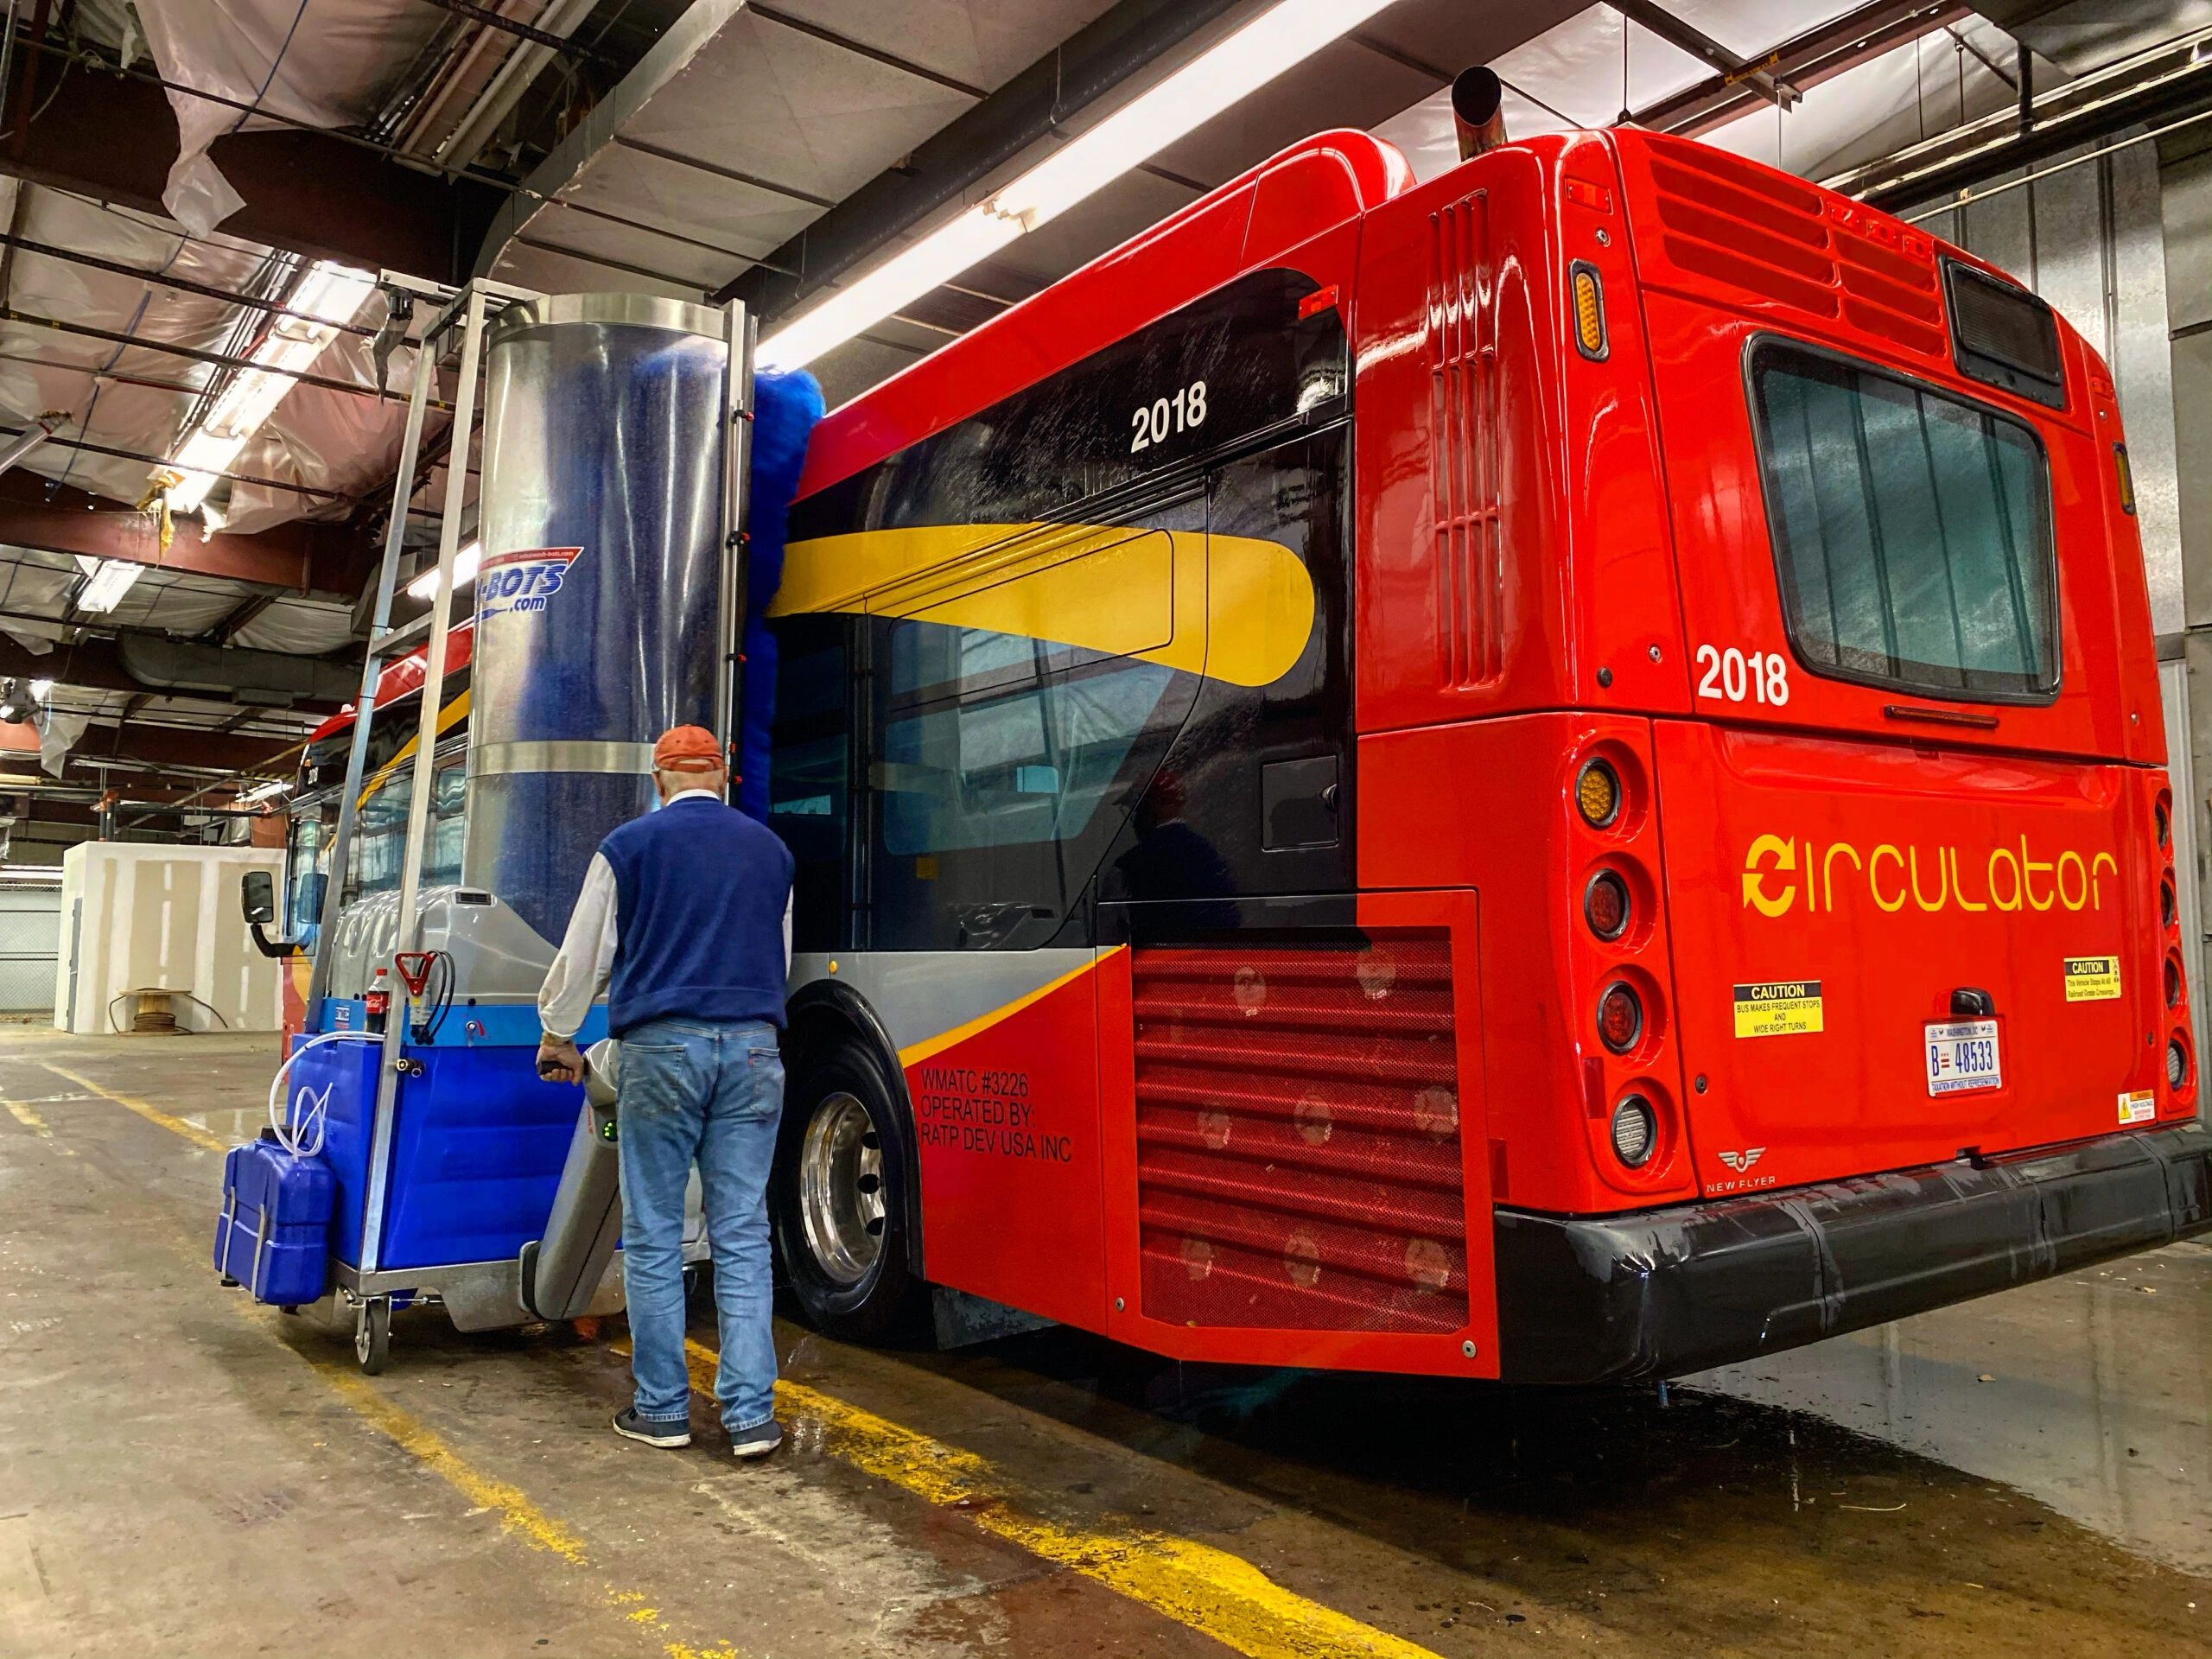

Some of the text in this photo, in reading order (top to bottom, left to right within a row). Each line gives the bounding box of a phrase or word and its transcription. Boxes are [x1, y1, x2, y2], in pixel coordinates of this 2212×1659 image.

[1131, 380, 1207, 454] 2018
[509, 596, 546, 613] .com
[1696, 644, 1789, 707] 2018
[2072, 961, 2104, 975] CAUTION
[1751, 983, 1806, 1000] CAUTION
[1737, 1000, 1821, 1014] BUS MAKES FREQUENT STOPS
[1774, 1013, 1786, 1021] AND
[1753, 1021, 1807, 1033] WIDE RIGHT TURNS
[1931, 1040, 1993, 1077] B 48533
[920, 1068, 1029, 1097] WMATC #3226
[920, 1095, 1036, 1128] OPERATED BY:
[921, 1122, 1071, 1162] RATP DEV USA INC
[1707, 1175, 1776, 1193] NEW FLYER
